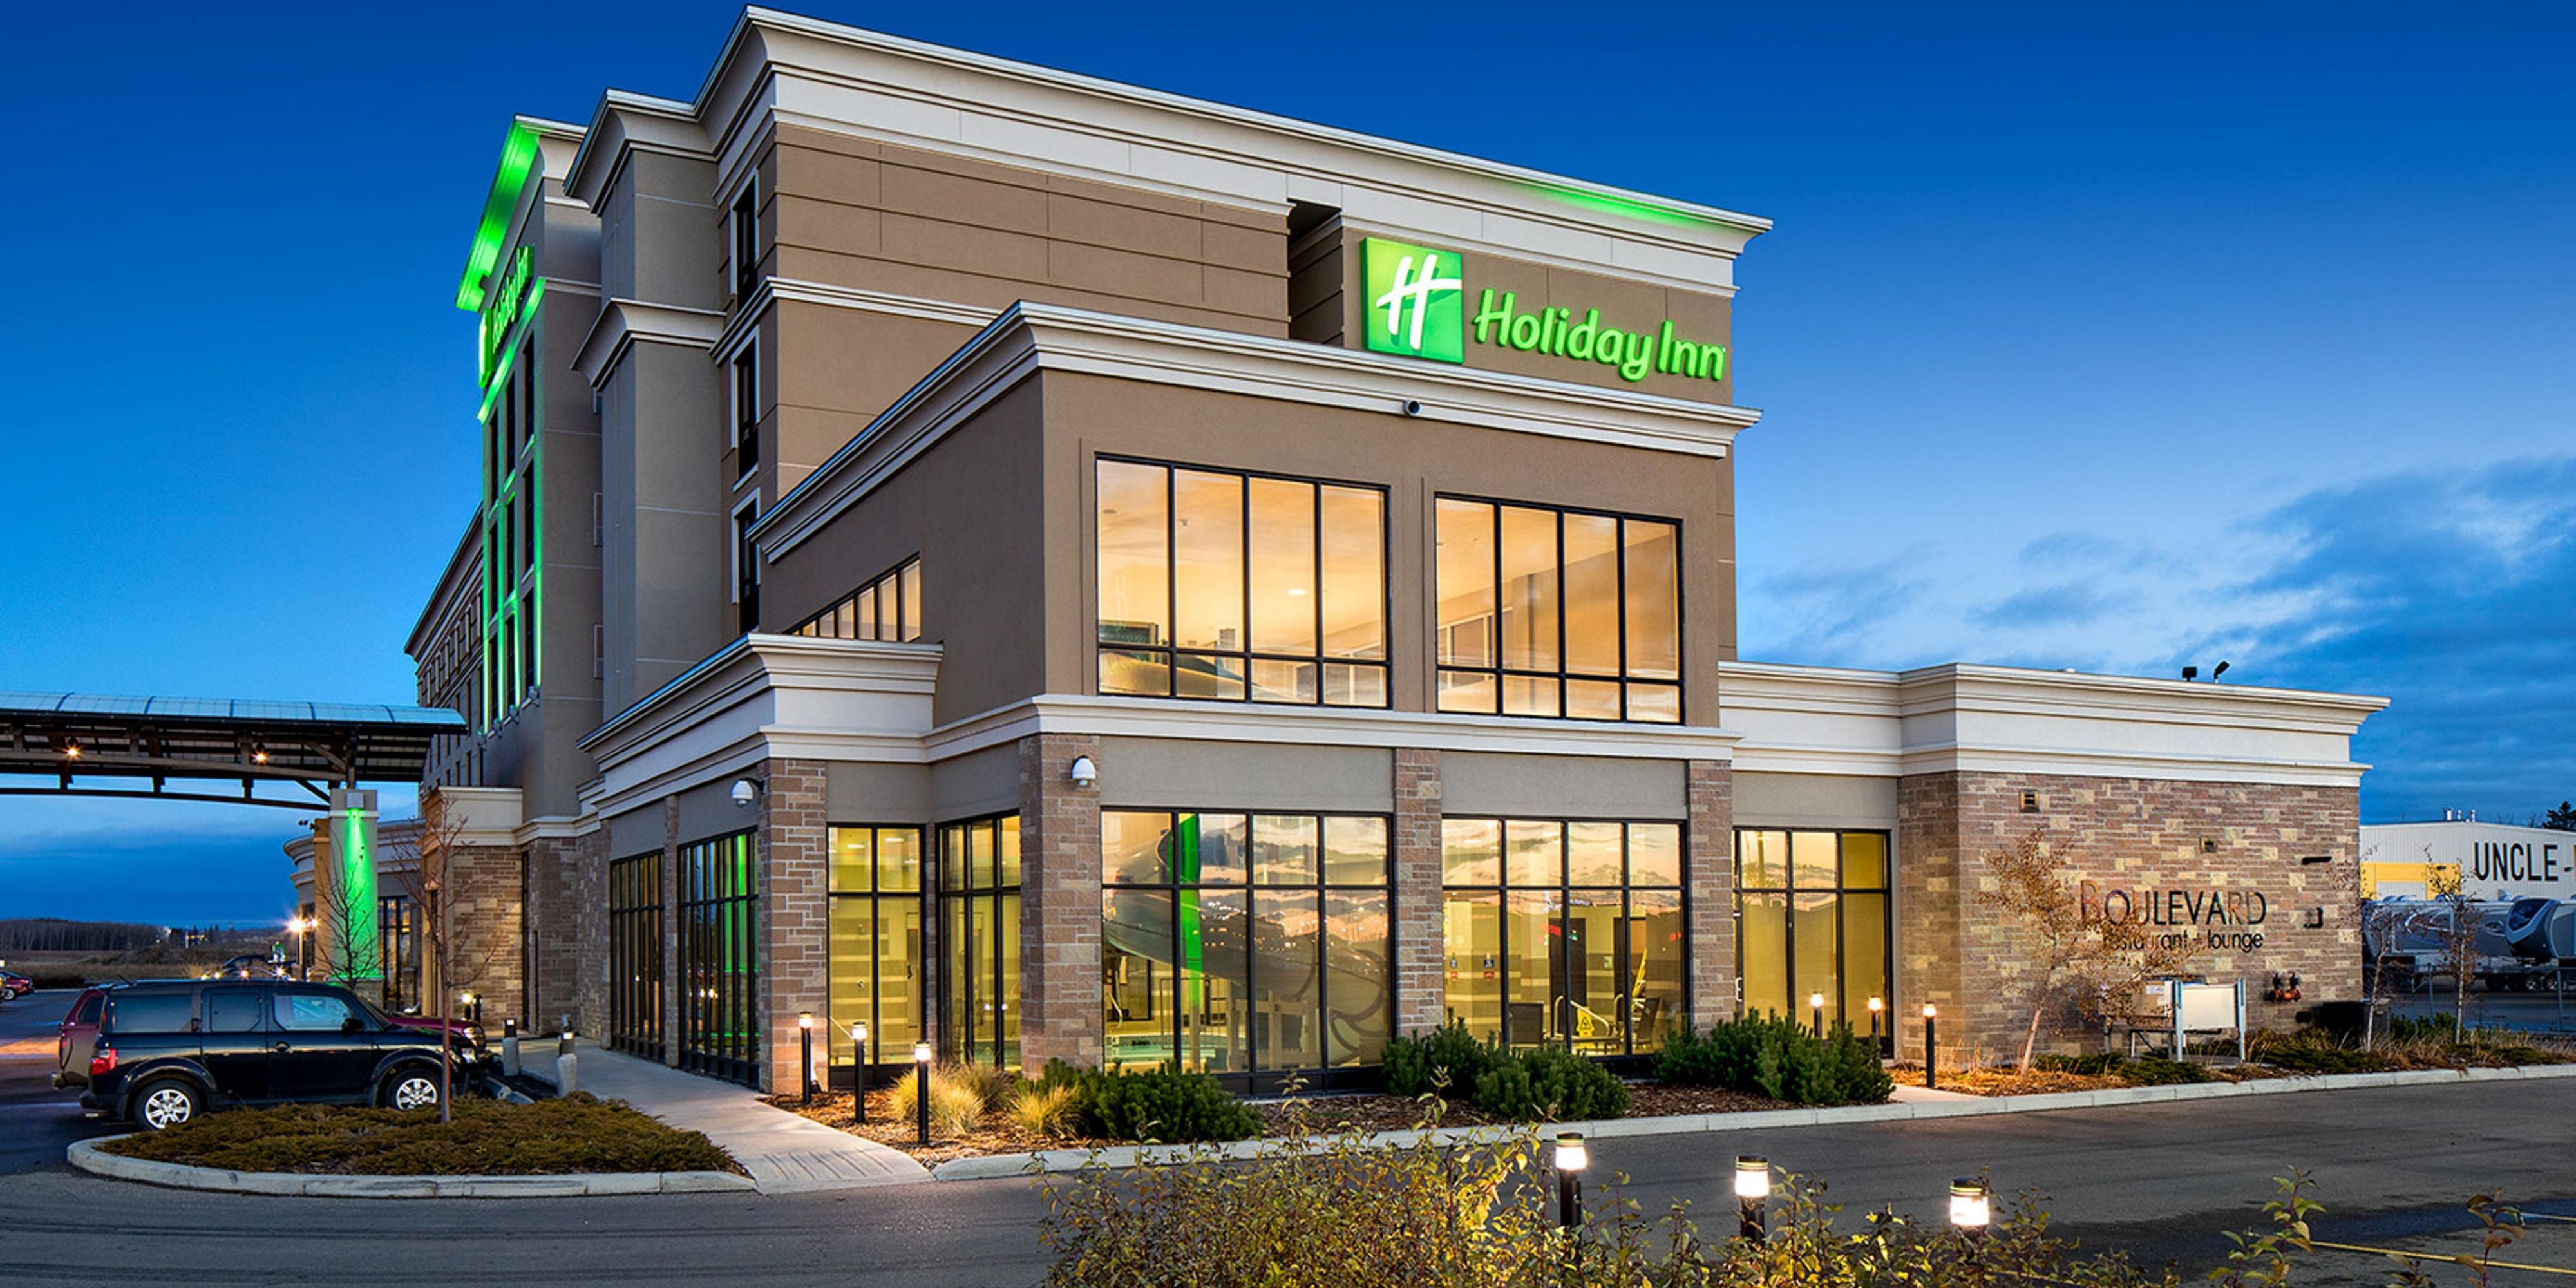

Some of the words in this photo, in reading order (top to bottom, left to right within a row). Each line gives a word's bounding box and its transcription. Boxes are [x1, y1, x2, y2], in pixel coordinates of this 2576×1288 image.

[1376, 254, 1462, 350] H
[1473, 288, 1653, 382] Holiday
[1657, 320, 1727, 381] Inn
[2081, 880, 2267, 926] BOULEVARD
[2207, 929, 2264, 953] lounge
